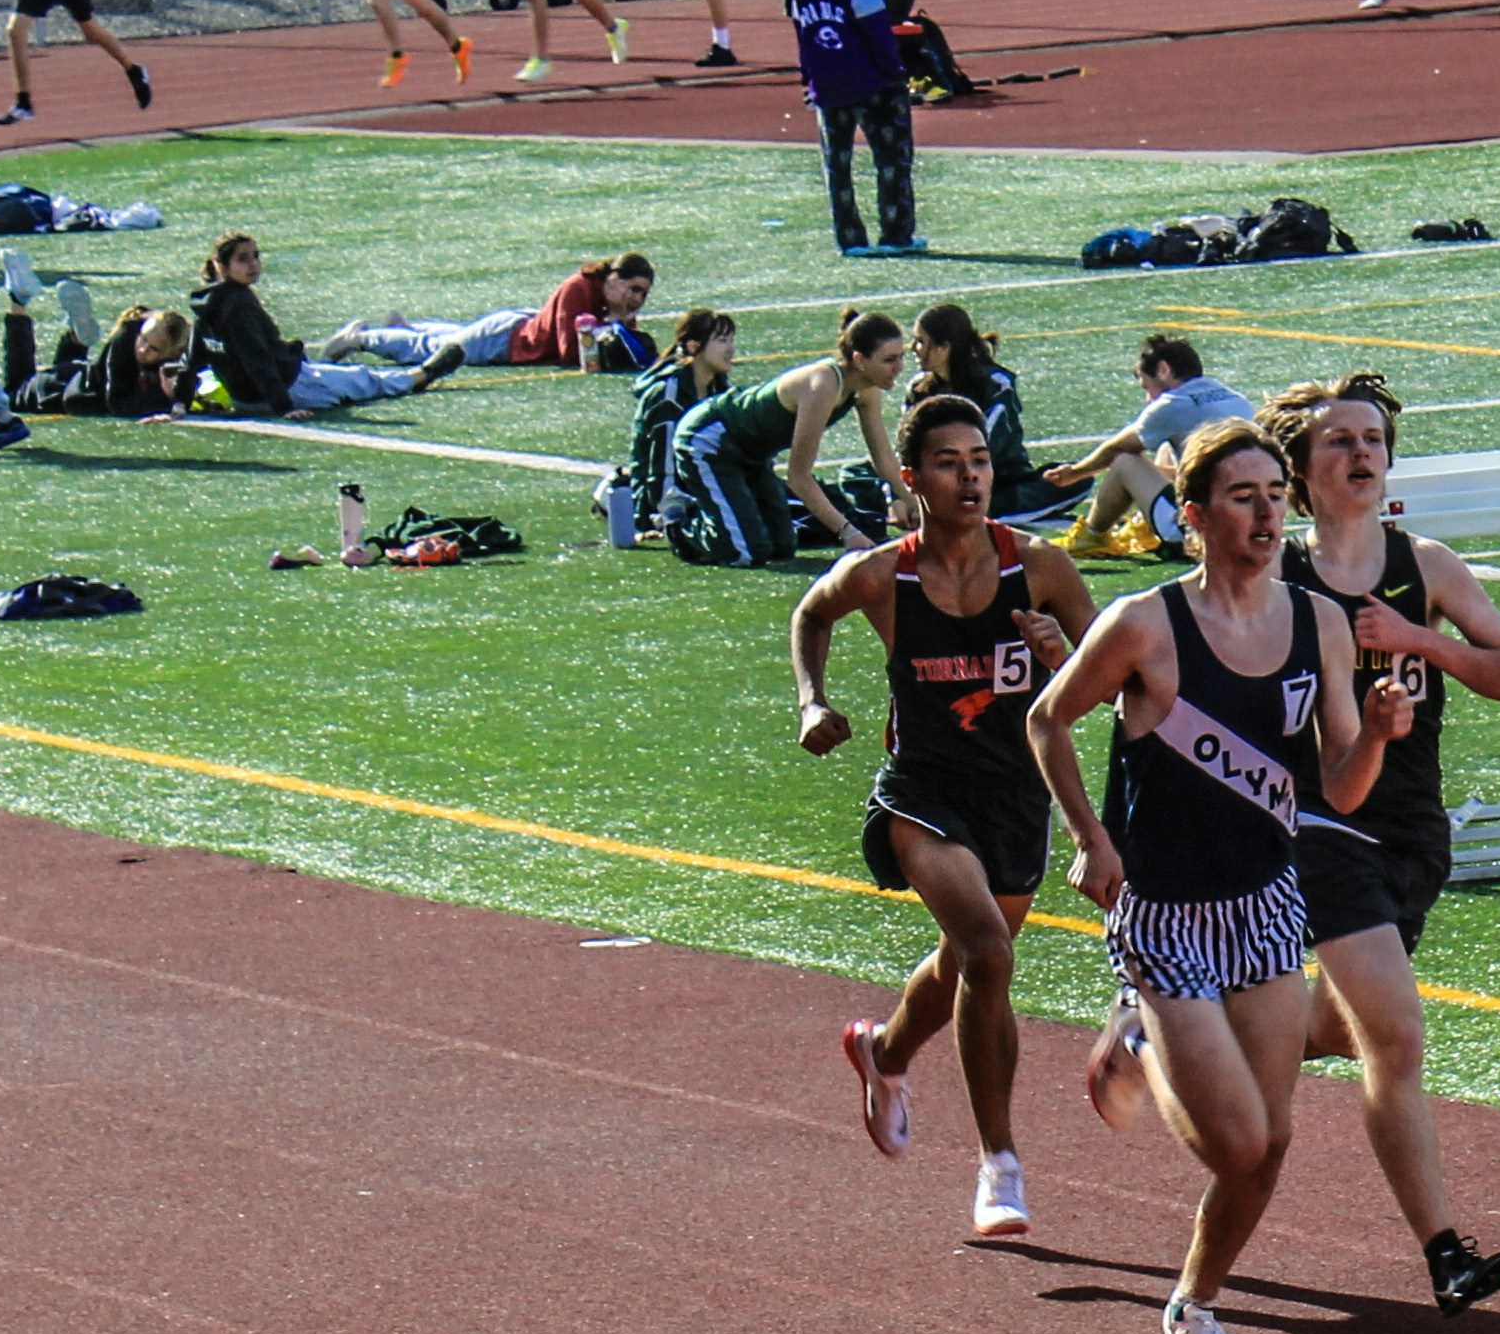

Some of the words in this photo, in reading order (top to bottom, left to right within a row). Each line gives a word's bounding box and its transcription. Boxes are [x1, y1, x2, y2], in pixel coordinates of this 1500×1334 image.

[1001, 643, 1027, 687] 5
[1400, 653, 1423, 697] 6
[1289, 679, 1315, 726] 7
